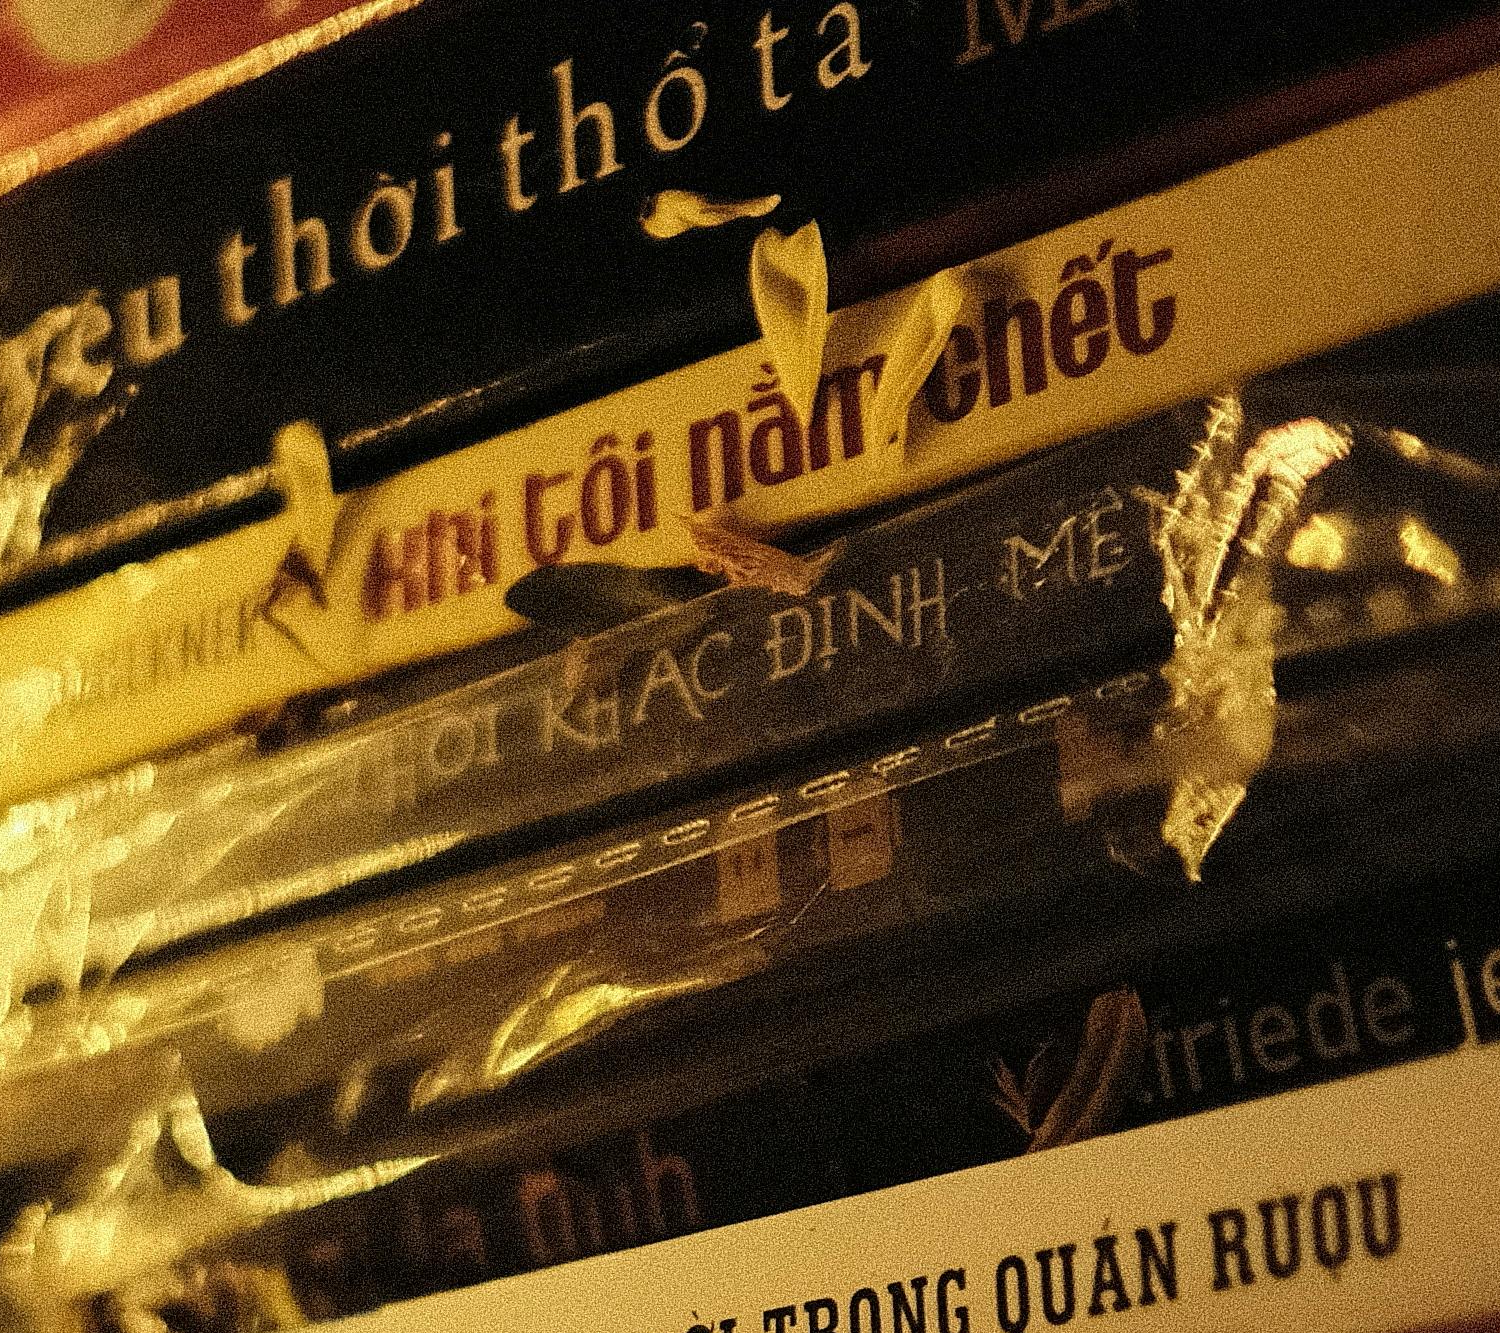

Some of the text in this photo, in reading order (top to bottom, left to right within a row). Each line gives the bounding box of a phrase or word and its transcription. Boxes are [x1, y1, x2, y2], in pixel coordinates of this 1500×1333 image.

[215, 129, 464, 330] thời
[496, 18, 712, 217] thổ
[523, 430, 659, 566] tôi
[922, 238, 1178, 423] chết
[1003, 485, 1165, 600] MỆ
[1134, 960, 1418, 1106] friede
